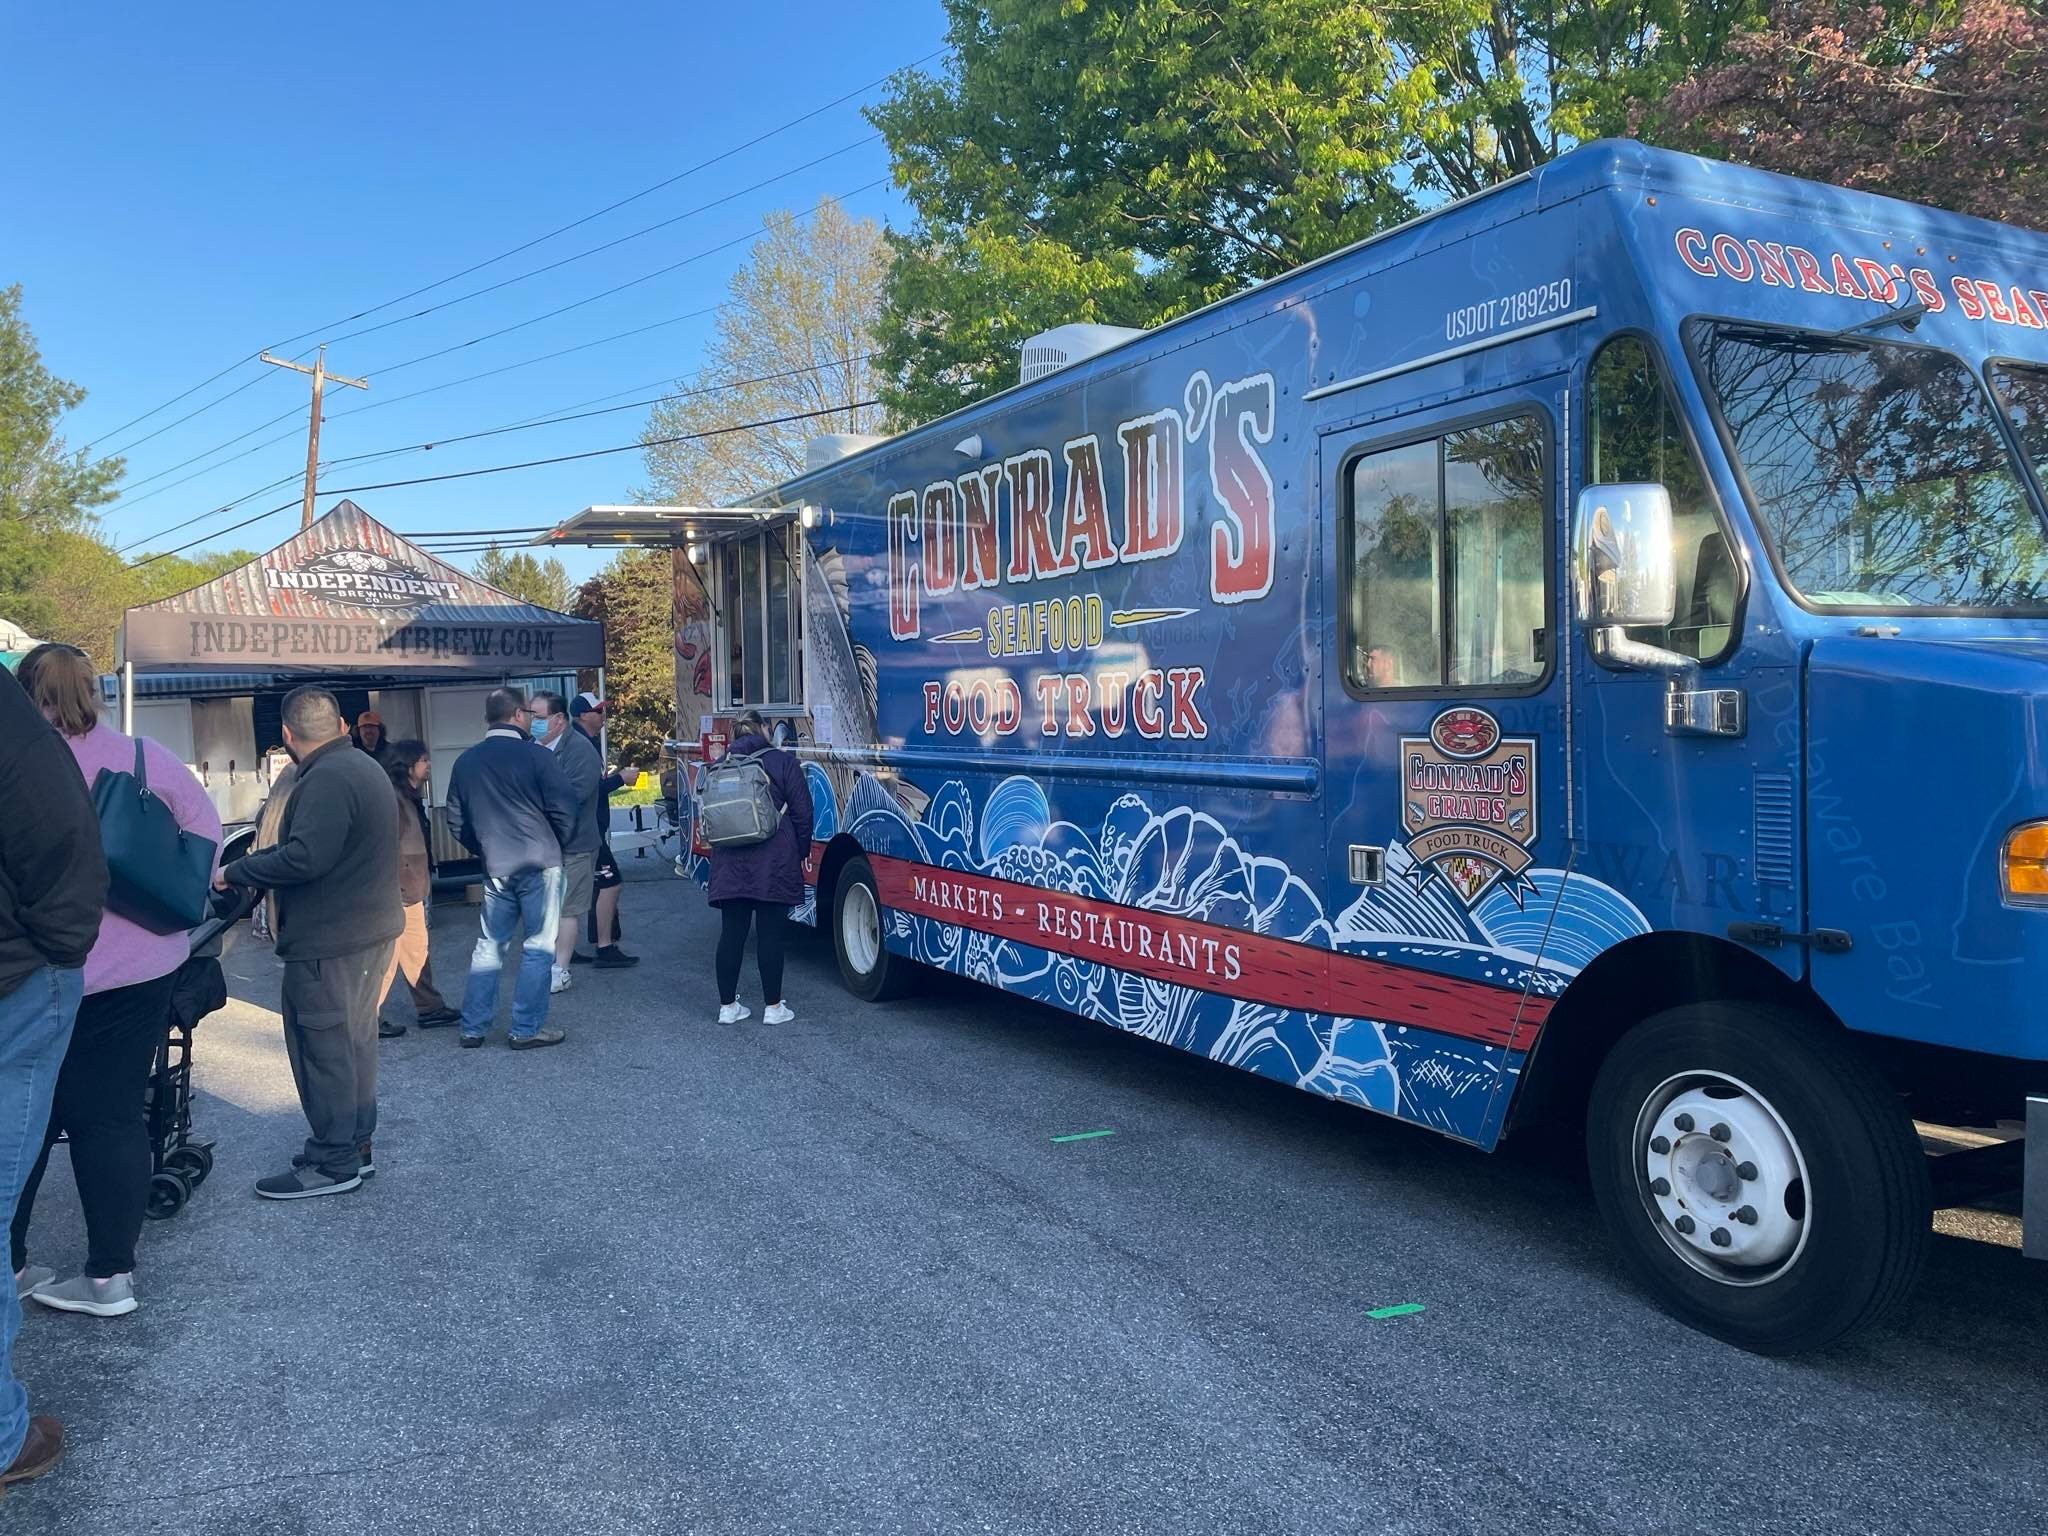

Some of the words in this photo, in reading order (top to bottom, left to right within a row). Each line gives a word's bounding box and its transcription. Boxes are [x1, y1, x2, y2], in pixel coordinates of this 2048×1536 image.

[1674, 227, 1946, 314] CONRAD'S
[1446, 299, 1497, 341] USDOT
[1499, 277, 1571, 327] 2189250
[887, 369, 1276, 642] CONRAD'S
[266, 568, 460, 600] INDEPENDENT
[338, 589, 401, 600] BREWING
[190, 620, 555, 662] INDEPENDENTBREW.COM
[987, 594, 1103, 658] SEAFOOD
[923, 677, 1022, 736] FOOD
[1036, 666, 1209, 740] TRUCK
[1408, 754, 1527, 795] CONRAD'S
[1428, 795, 1506, 823] CRABS
[1426, 833, 1461, 852] FOOD
[1464, 833, 1509, 860] TRUCK
[913, 876, 1003, 921] MARKETS
[1037, 902, 1242, 981] RESTAURANTS
[1871, 919, 1942, 1009] Bay
